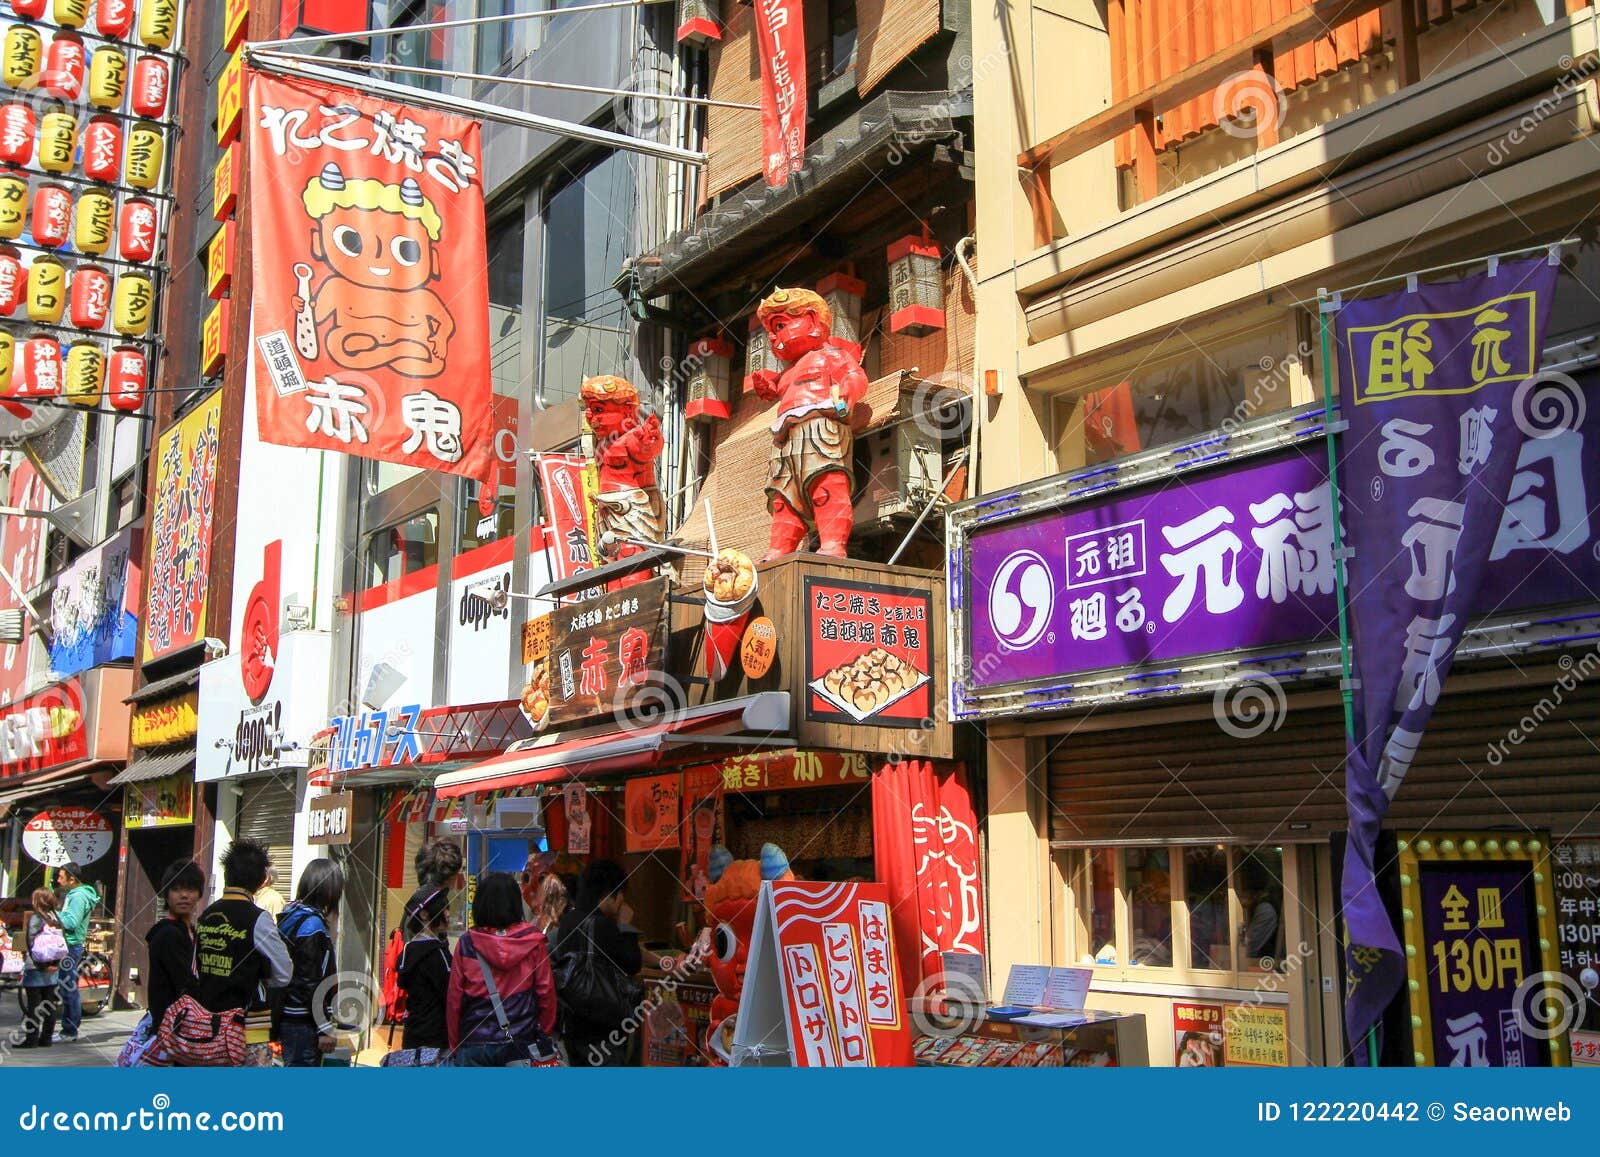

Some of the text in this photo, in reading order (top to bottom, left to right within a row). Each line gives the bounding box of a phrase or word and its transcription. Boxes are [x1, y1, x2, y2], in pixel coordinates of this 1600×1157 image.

[267, 338, 300, 388] 道頓堀
[305, 376, 463, 463] 赤鬼
[1074, 531, 1136, 578] 元祖
[815, 591, 881, 616] たこ焼き
[819, 617, 876, 644] 道頓堀
[579, 626, 649, 696] 赤鬼
[1440, 883, 1505, 932] 全皿
[862, 913, 892, 1010] はまち
[1432, 937, 1524, 993] 130円
[827, 934, 865, 1061] ビントロ
